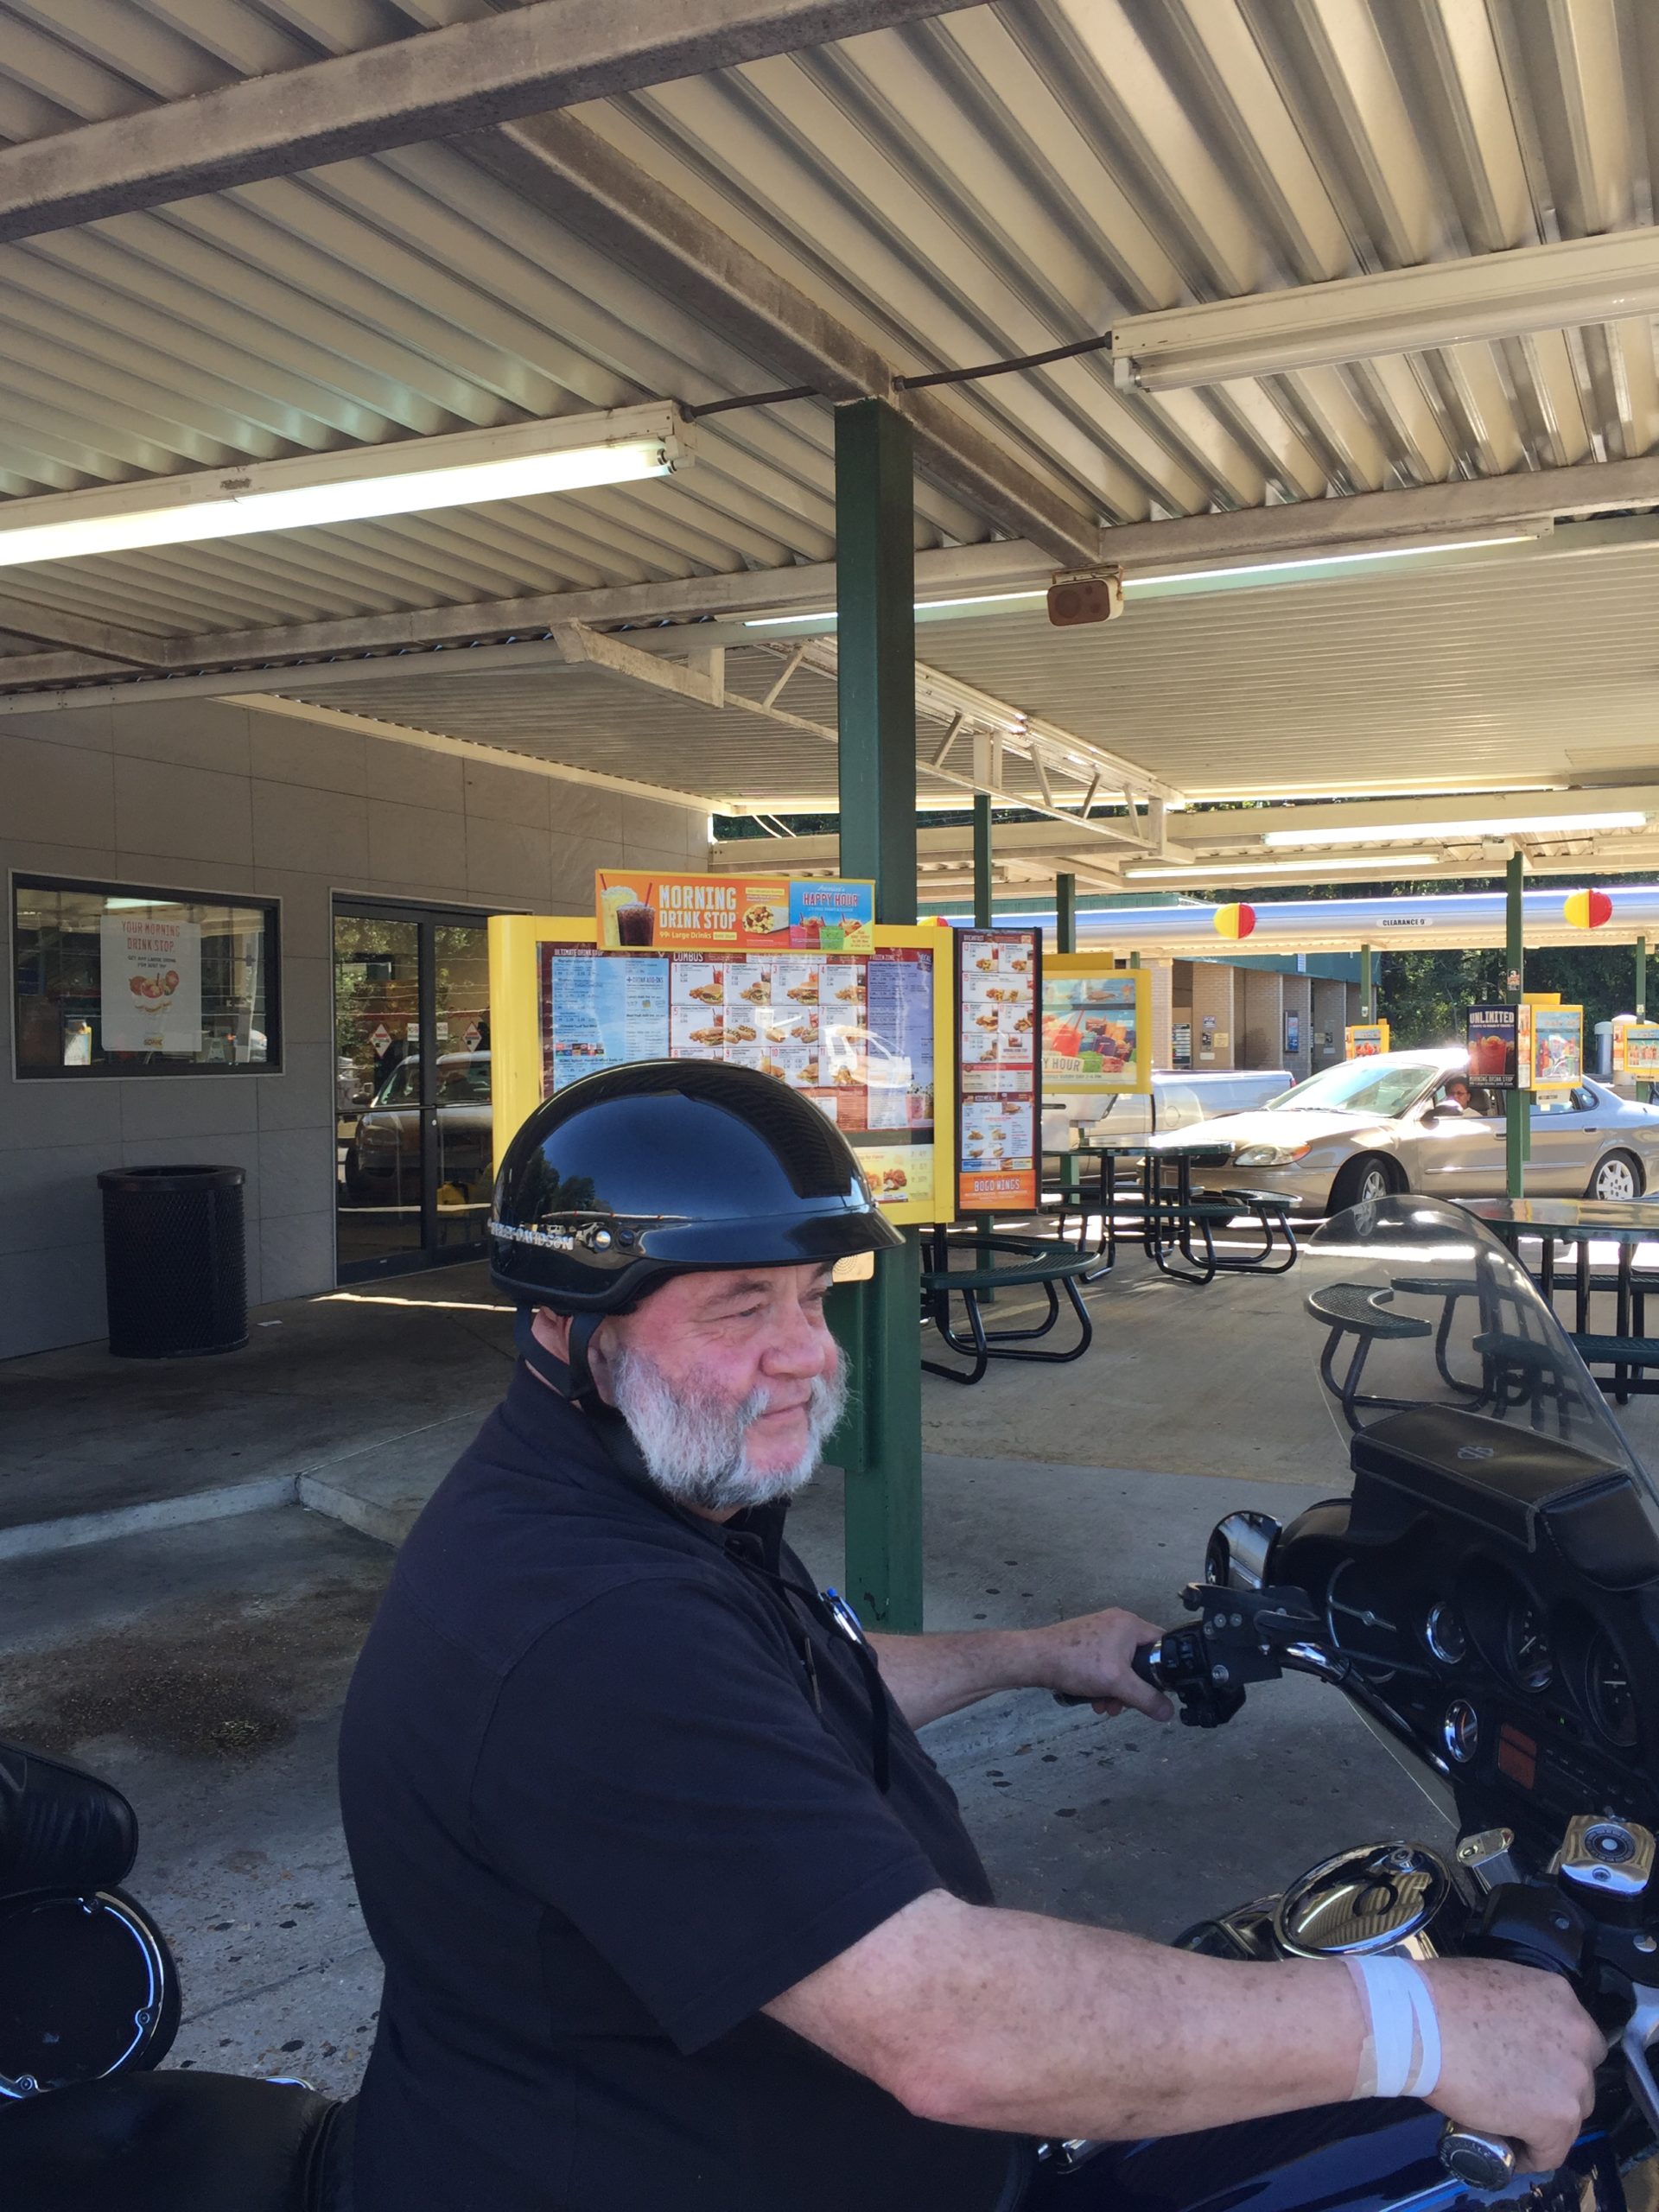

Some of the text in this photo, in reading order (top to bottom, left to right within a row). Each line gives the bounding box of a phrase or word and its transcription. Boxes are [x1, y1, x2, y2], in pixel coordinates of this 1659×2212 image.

[659, 884, 736, 910] MORNING
[803, 893, 859, 907] HAPPY HOUR
[660, 910, 736, 931] DRINK STOP
[122, 920, 181, 937] YOUR MORNING
[671, 931, 690, 941] Large
[127, 938, 175, 952] DRINK STOP
[673, 951, 703, 962] COMBOS
[1470, 1010, 1515, 1024] UNLIMITED
[1052, 1058, 1080, 1071] HOUR
[974, 1179, 1020, 1192] BOGO WINGS
